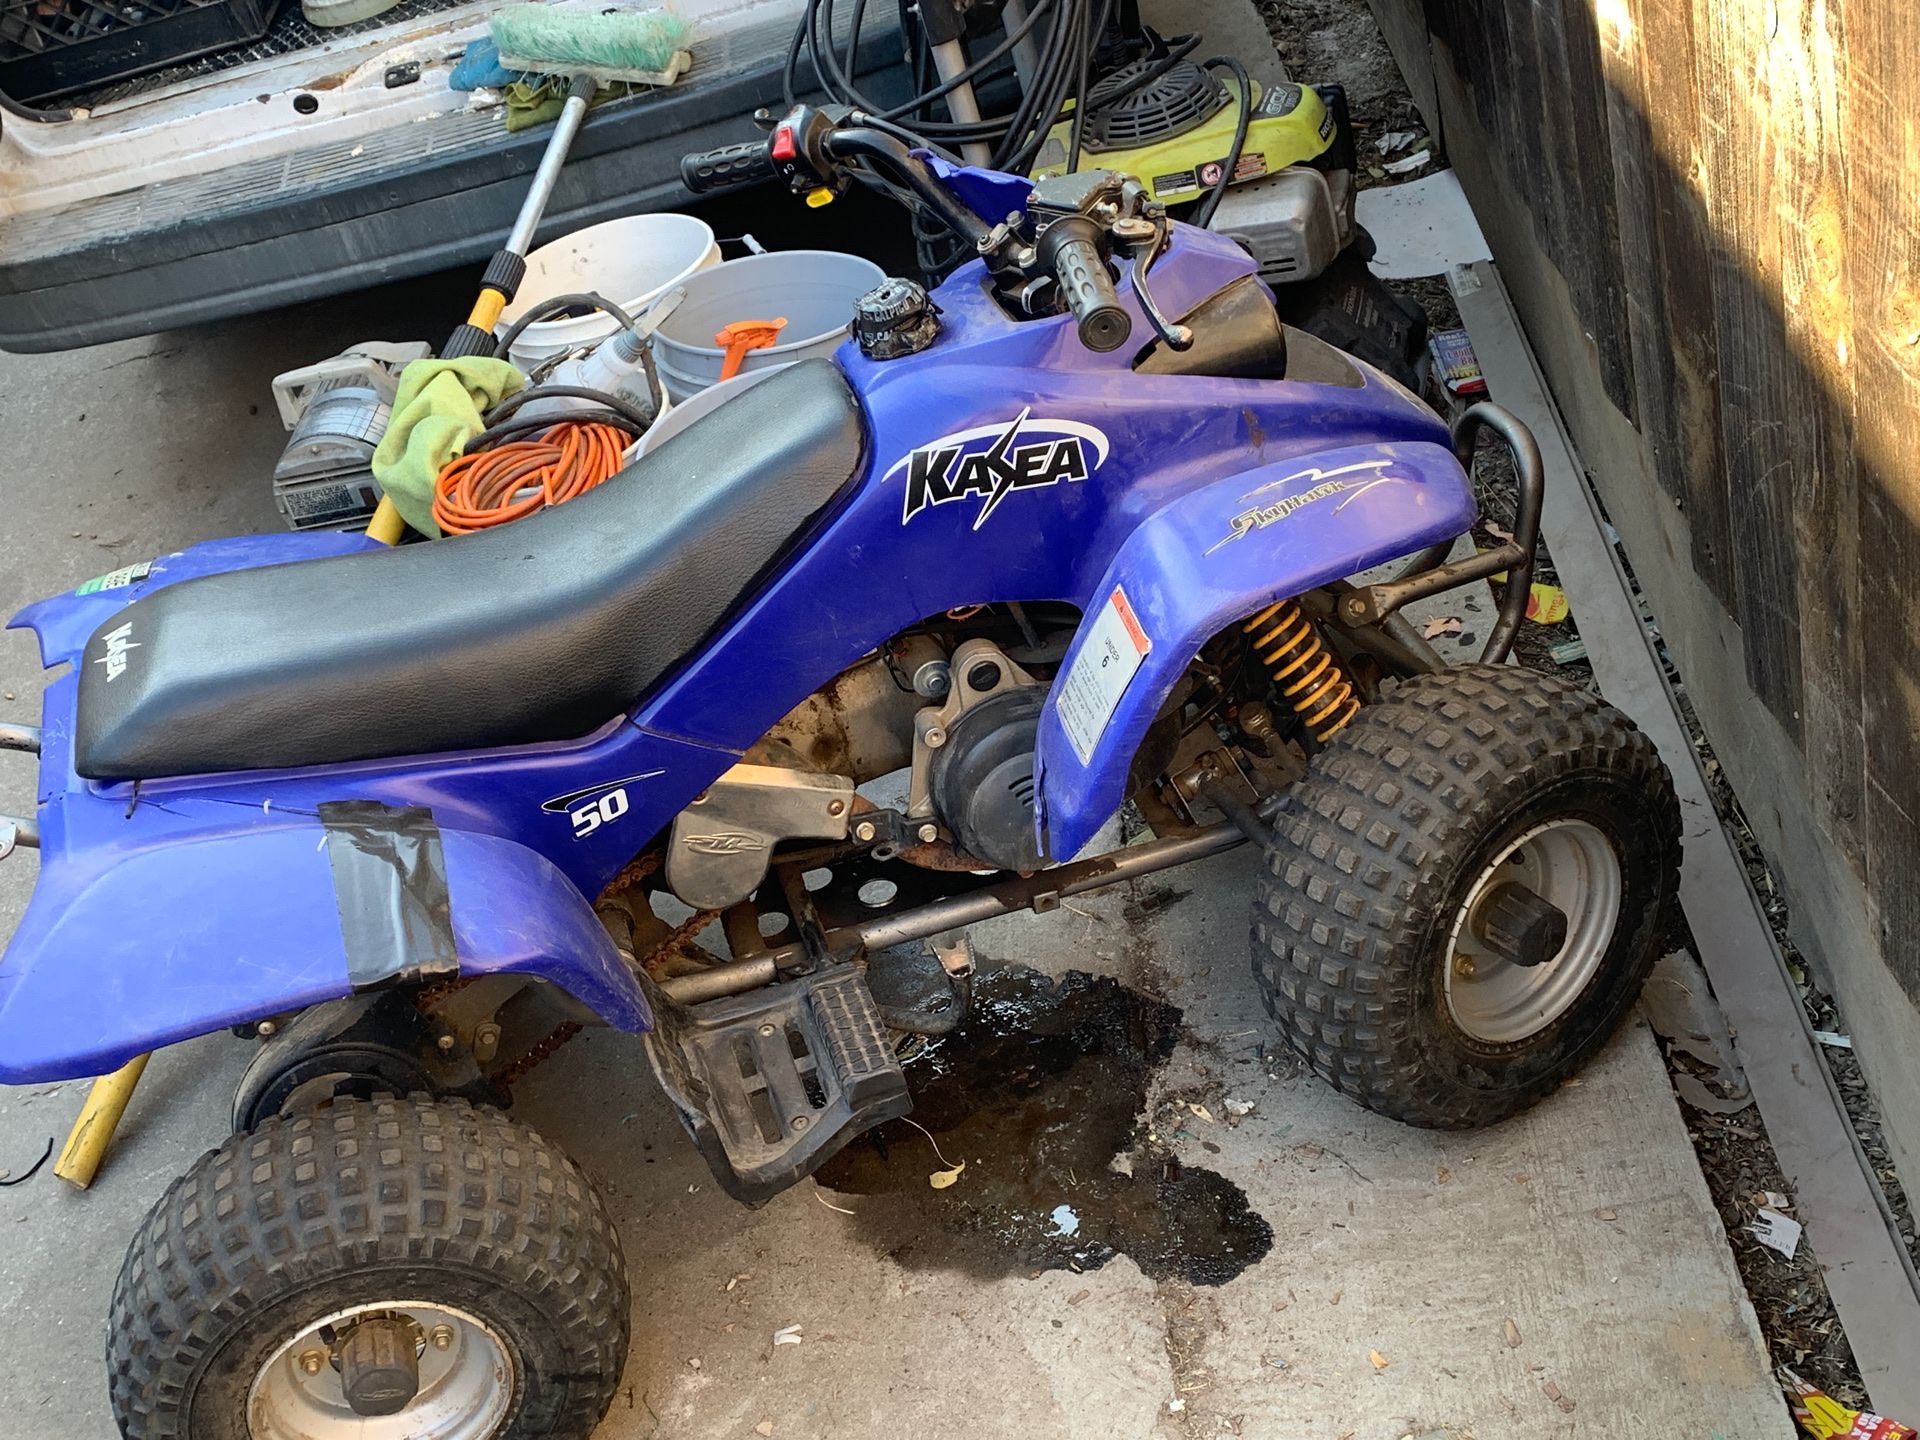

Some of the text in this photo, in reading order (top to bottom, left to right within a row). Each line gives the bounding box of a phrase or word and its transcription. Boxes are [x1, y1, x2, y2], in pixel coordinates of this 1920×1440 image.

[902, 407, 1088, 531] KASEA
[1101, 655, 1110, 668] 6
[1104, 636, 1120, 664] UNDER
[571, 788, 629, 838] 50
